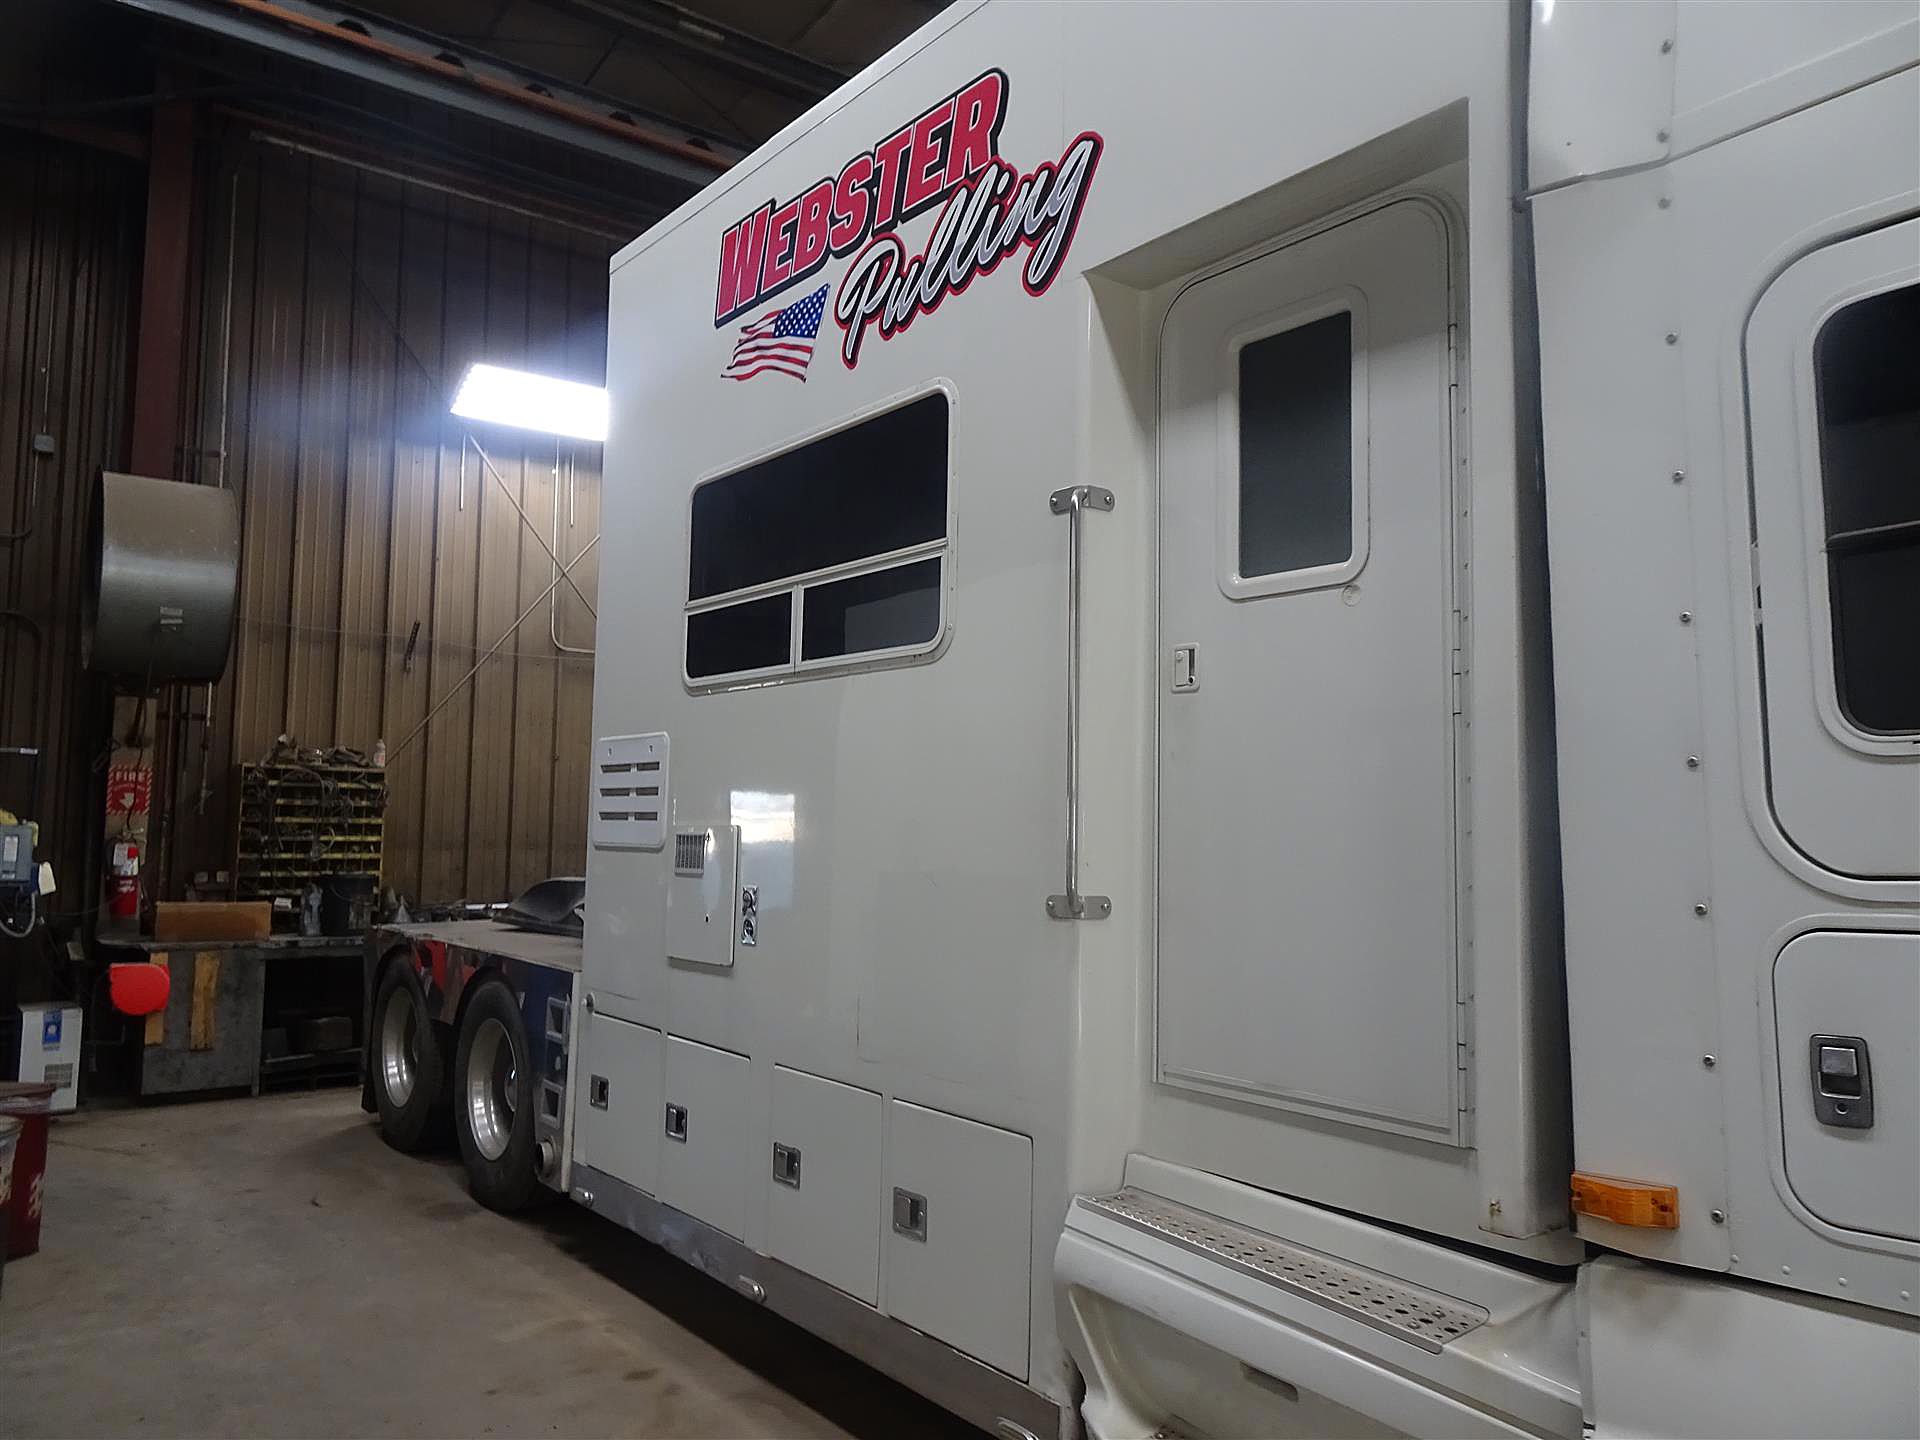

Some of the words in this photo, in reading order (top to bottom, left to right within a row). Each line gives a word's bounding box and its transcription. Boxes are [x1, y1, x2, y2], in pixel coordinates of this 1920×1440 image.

[714, 67, 1009, 329] WEBSTER
[834, 131, 1104, 369] Pulling
[115, 771, 146, 782] FIRE
